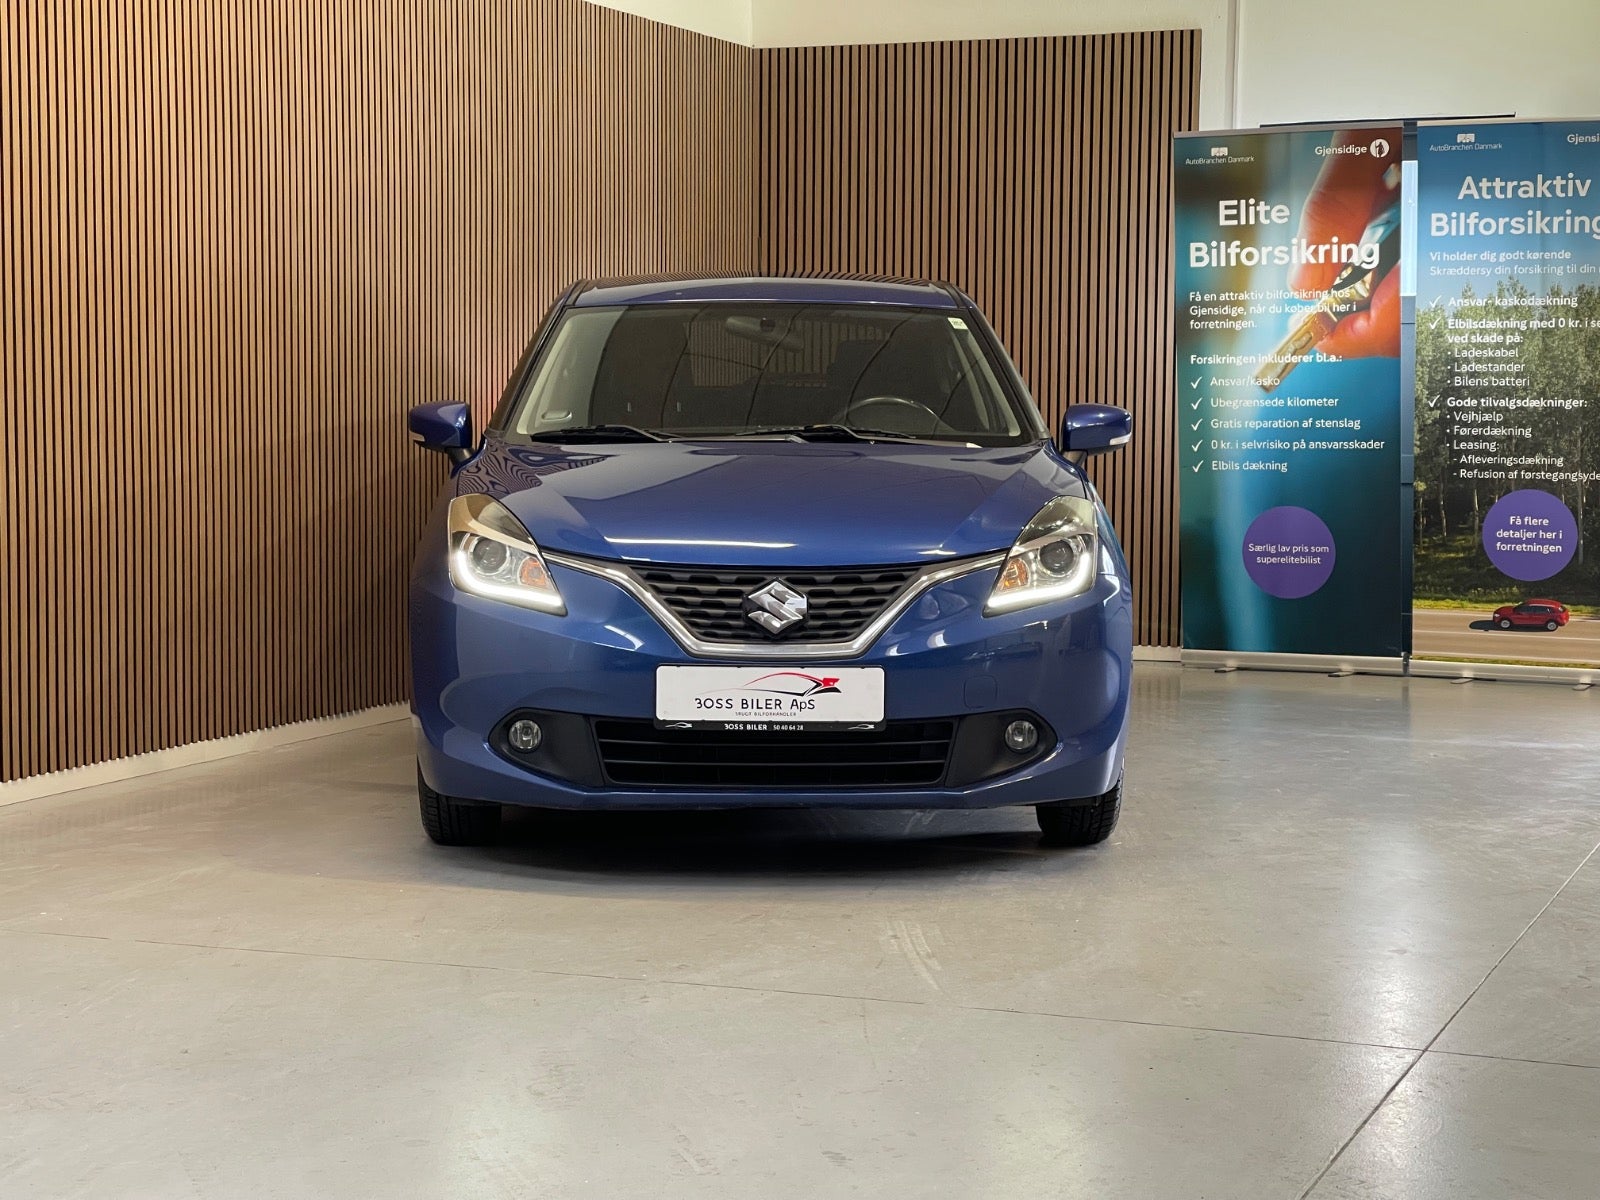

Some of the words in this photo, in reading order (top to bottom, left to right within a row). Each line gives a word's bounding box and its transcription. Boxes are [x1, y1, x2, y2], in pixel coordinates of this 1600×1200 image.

[1567, 133, 1600, 145] Gjensi
[1314, 144, 1367, 158] Gjensidige
[1474, 142, 1502, 150] Danmark
[1457, 172, 1592, 200] Attraktiv
[1218, 198, 1290, 226] Elite
[1189, 236, 1380, 270] Bilforsikring
[1430, 251, 1441, 262] Vi
[1442, 250, 1478, 261] holder
[1480, 250, 1496, 263] dig
[1499, 250, 1525, 262] godt
[1526, 249, 1572, 260] kørende
[1430, 266, 1492, 276] Skræddersy
[1494, 265, 1511, 275] din
[1514, 264, 1564, 276] forsikring
[1566, 264, 1577, 274] til
[1580, 263, 1596, 274] din
[1189, 291, 1202, 302] Få
[1204, 293, 1217, 302] en
[1219, 290, 1264, 301] attraktiv
[1266, 288, 1329, 301] bilforsikring
[1330, 288, 1351, 298] hos
[1494, 296, 1578, 308] kaskodækning
[1189, 304, 1248, 316] Gjensidige,
[1250, 303, 1266, 314] når
[1268, 302, 1282, 314] du
[1317, 302, 1330, 312] bil
[1332, 302, 1350, 312] her
[1353, 302, 1356, 312] i
[1189, 318, 1258, 330] forretningen.
[1448, 318, 1528, 330] Elbilsdækning
[1530, 318, 1556, 328] med
[1558, 318, 1566, 328] 0
[1568, 318, 1582, 328] kr.
[1585, 318, 1588, 328] i
[1447, 332, 1468, 344] ved
[1470, 332, 1504, 344] skade
[1506, 332, 1524, 345] på:
[1190, 352, 1256, 366] Forsikringen
[1258, 352, 1314, 364] inkluderer
[1454, 348, 1520, 358] Ladeskabel
[1454, 362, 1526, 372] Ladestander
[1210, 376, 1280, 387] Ansvar/kasko
[1454, 376, 1488, 387] Bilens
[1492, 376, 1530, 387] batteri
[1210, 398, 1285, 410] Ubegrænsede
[1287, 397, 1339, 407] kilometer
[1446, 397, 1478, 408] Gode
[1480, 397, 1588, 410] tilvalgsdækninger:
[1210, 418, 1242, 428] Gratis
[1244, 418, 1300, 430] reparation
[1302, 418, 1313, 428] af
[1315, 418, 1361, 430] stenslag
[1454, 411, 1504, 424] Vejhjælp
[1454, 425, 1532, 438] Førerdækning
[1210, 440, 1218, 450] 0
[1220, 439, 1233, 450] kr.
[1235, 440, 1238, 450] i
[1241, 439, 1290, 450] selvrisiko
[1292, 438, 1306, 451] på
[1308, 439, 1385, 450] ansvarsskader
[1454, 440, 1500, 452] Leasing:
[1211, 460, 1240, 470] Elbils
[1242, 460, 1288, 472] dækning
[1460, 454, 1564, 468] Afleveringsdækning
[1460, 468, 1506, 479] Refusion
[1508, 468, 1518, 480] af
[1510, 516, 1522, 526] Få
[1524, 516, 1550, 526] flere
[1496, 528, 1537, 541] detaljer
[1539, 529, 1556, 540] her
[1560, 529, 1562, 539] i
[1248, 543, 1276, 554] Særlig
[1278, 544, 1290, 552] lav
[1292, 544, 1309, 554] pris
[1496, 542, 1562, 554] forretningen
[1256, 556, 1322, 565] superelitebilist
[741, 698, 782, 710] BILER
[790, 698, 816, 712] ApS
